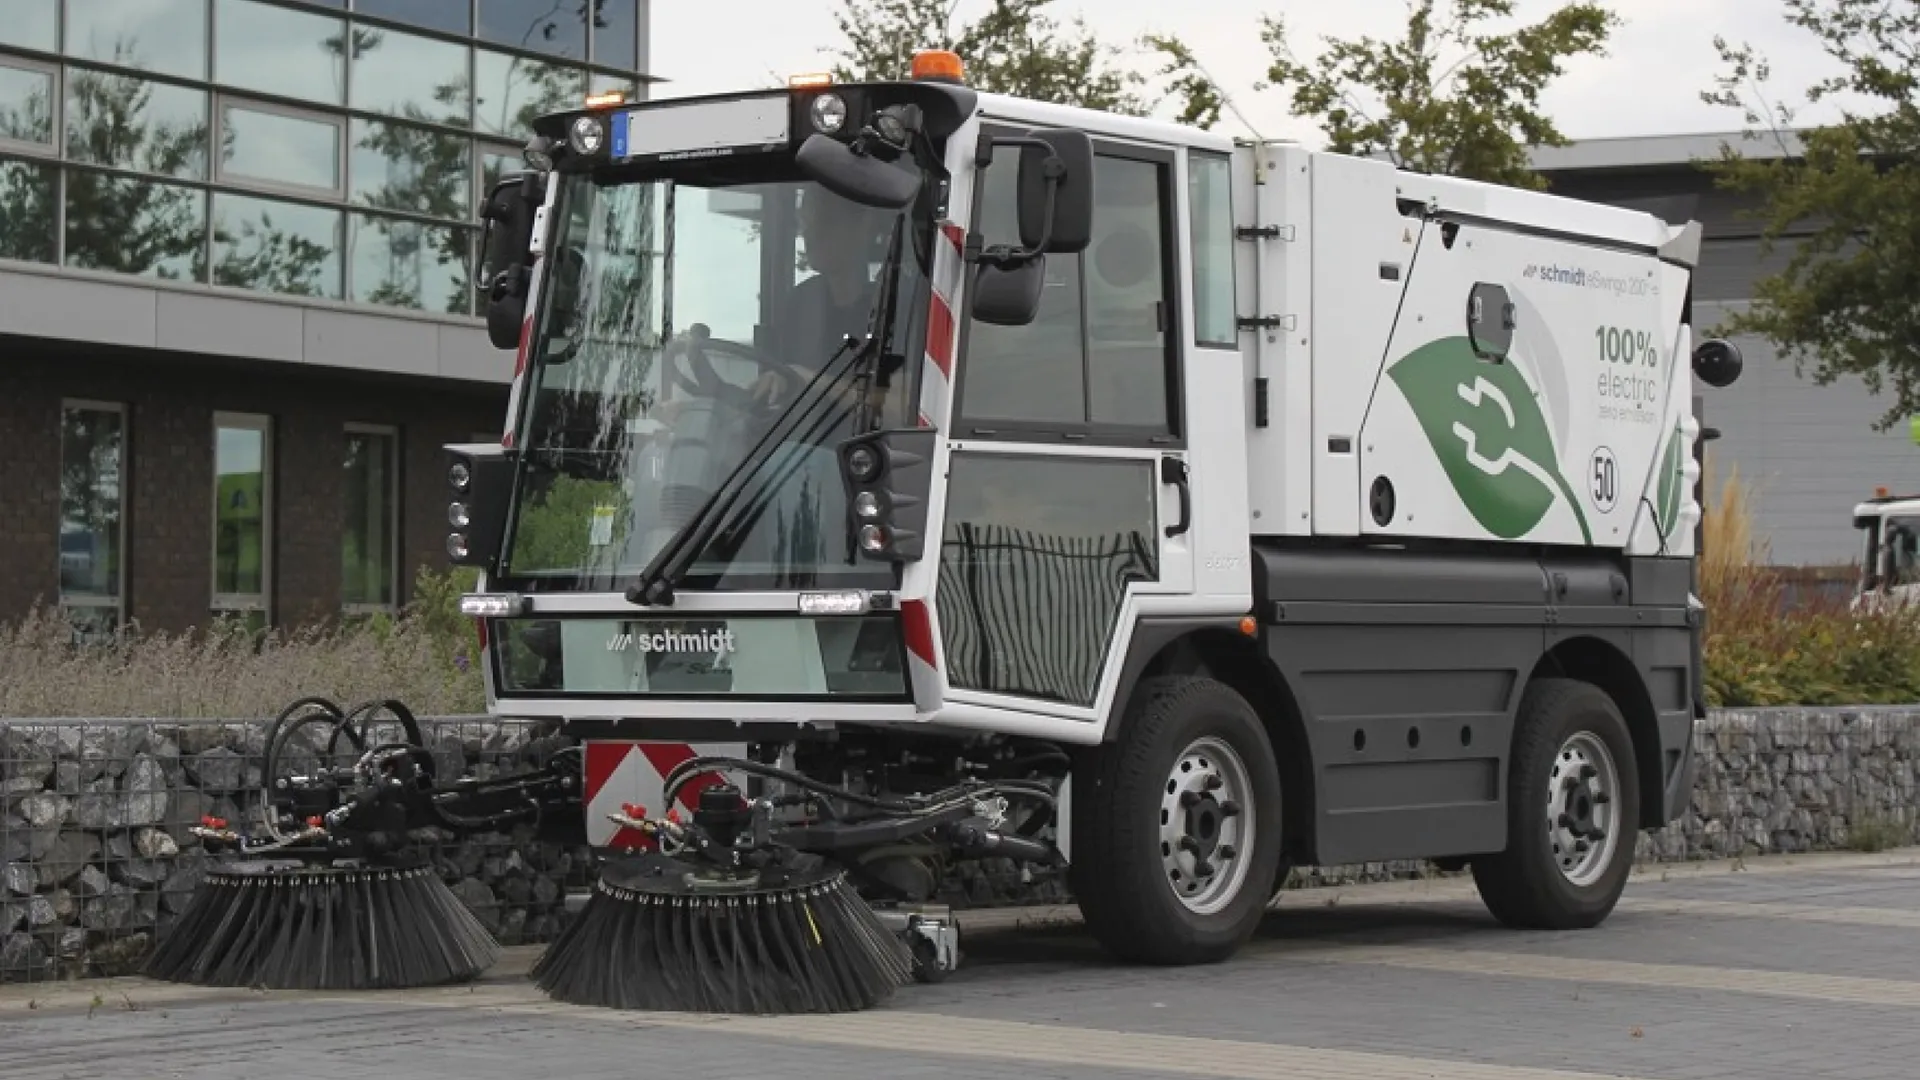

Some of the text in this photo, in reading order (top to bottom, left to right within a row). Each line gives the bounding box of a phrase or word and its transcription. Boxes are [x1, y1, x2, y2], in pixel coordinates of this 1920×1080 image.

[1540, 263, 1585, 286] schmidt
[1595, 325, 1657, 367] 100%
[1598, 367, 1656, 402] electric
[1595, 457, 1614, 500] 50
[639, 628, 735, 652] schmidt
